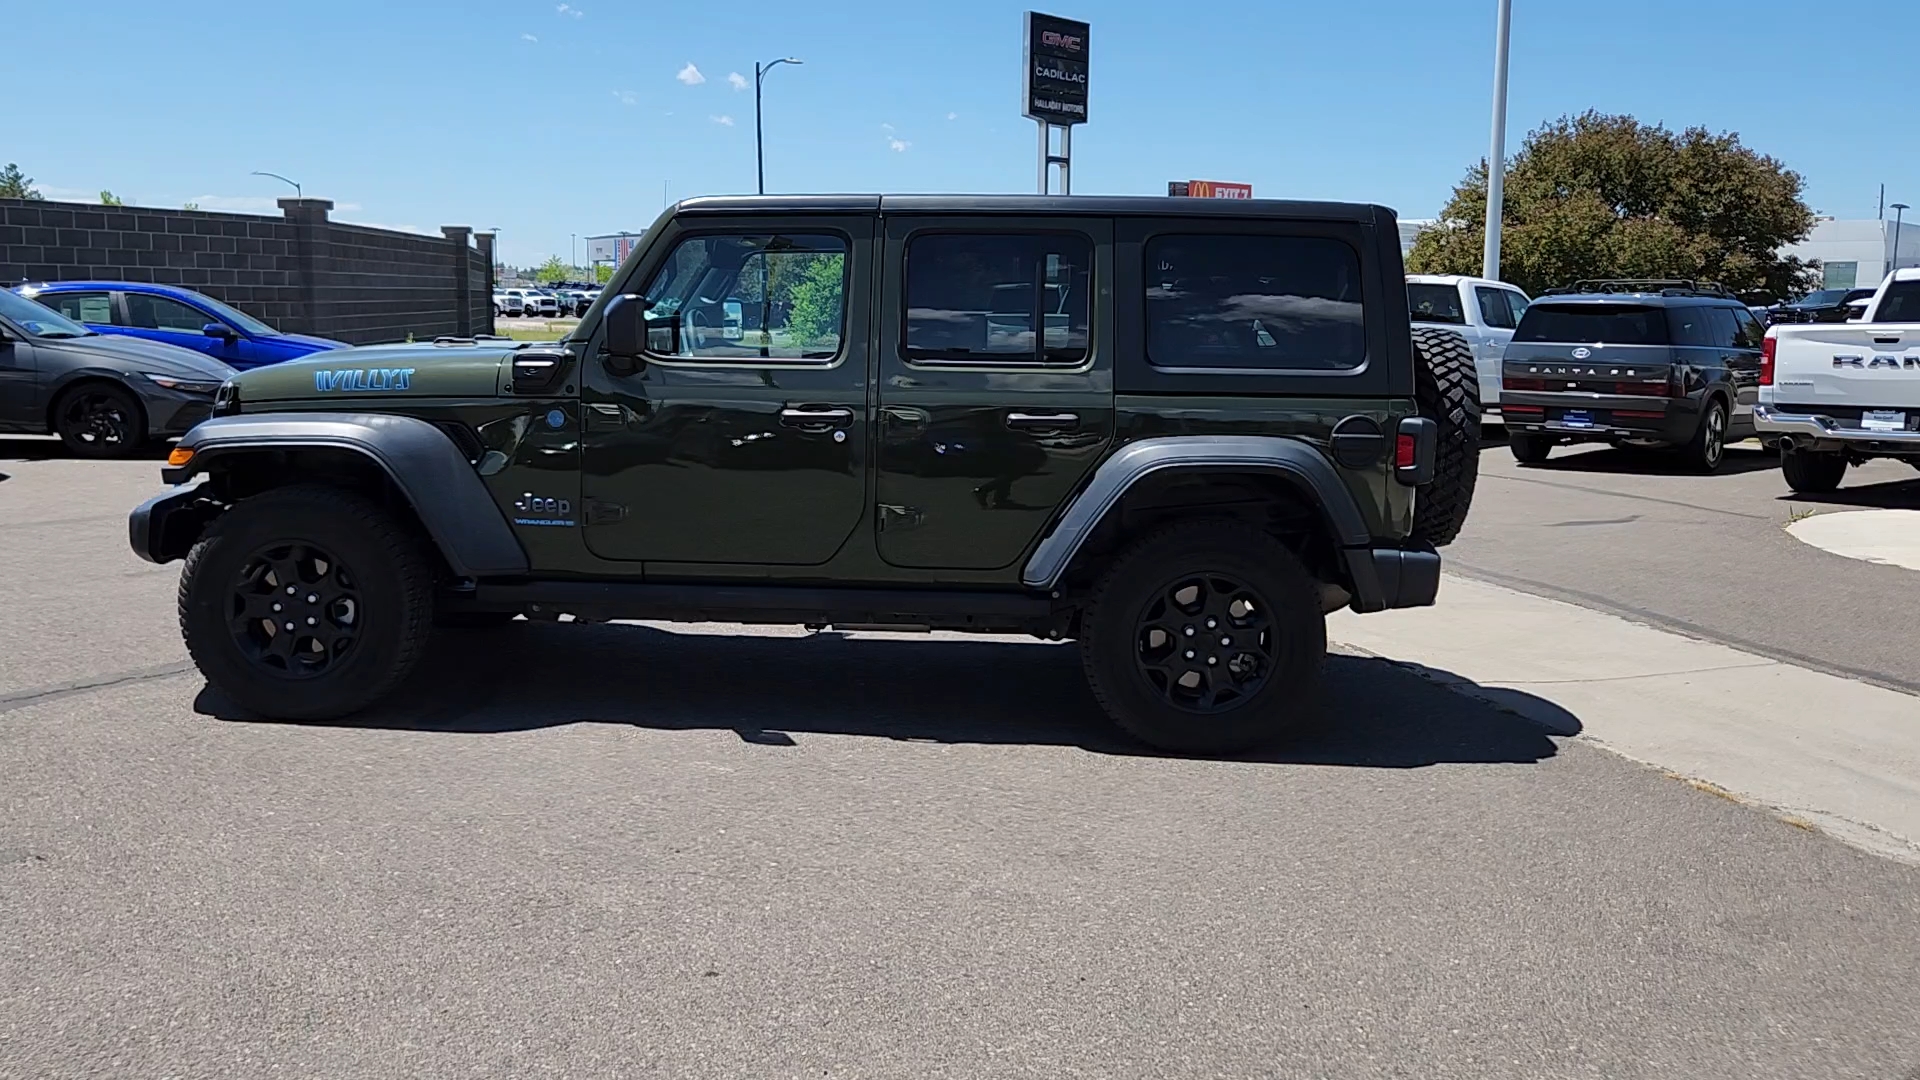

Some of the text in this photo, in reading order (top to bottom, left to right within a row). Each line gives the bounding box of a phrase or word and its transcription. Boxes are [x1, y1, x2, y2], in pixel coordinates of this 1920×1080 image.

[1042, 30, 1080, 51] GMC
[1035, 66, 1086, 83] CADILLAC
[1215, 187, 1239, 199] EXIT
[315, 368, 416, 392] WILLYS
[1529, 367, 1596, 376] SANTA
[514, 492, 571, 516] Jeep
